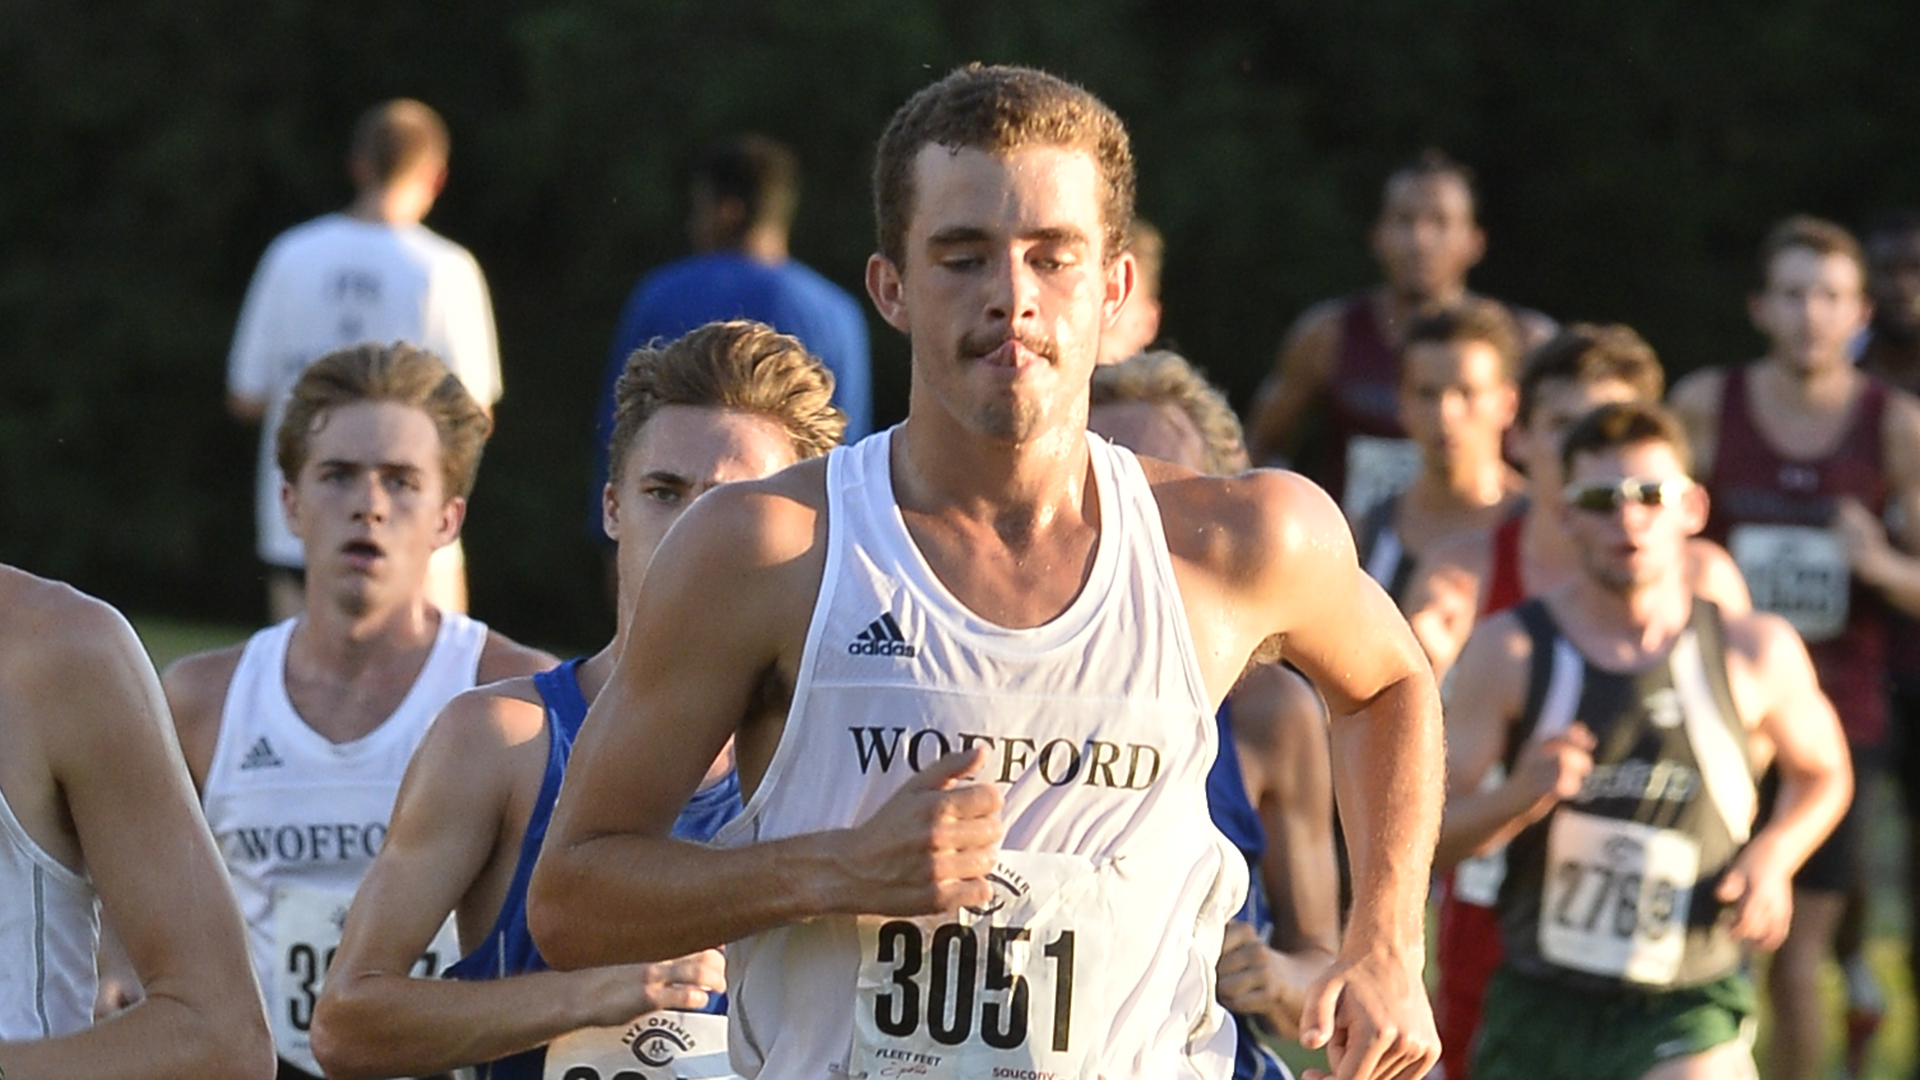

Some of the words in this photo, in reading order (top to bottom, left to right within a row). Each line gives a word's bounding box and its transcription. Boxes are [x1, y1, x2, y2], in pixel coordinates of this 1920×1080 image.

[848, 640, 915, 658] adidas
[874, 920, 1076, 1053] 3051
[621, 1023, 642, 1045] EYE
[648, 1017, 696, 1049] OPENER
[876, 1048, 912, 1062] FLEET
[913, 1053, 942, 1067] FEET
[992, 1066, 1054, 1080] saucony
